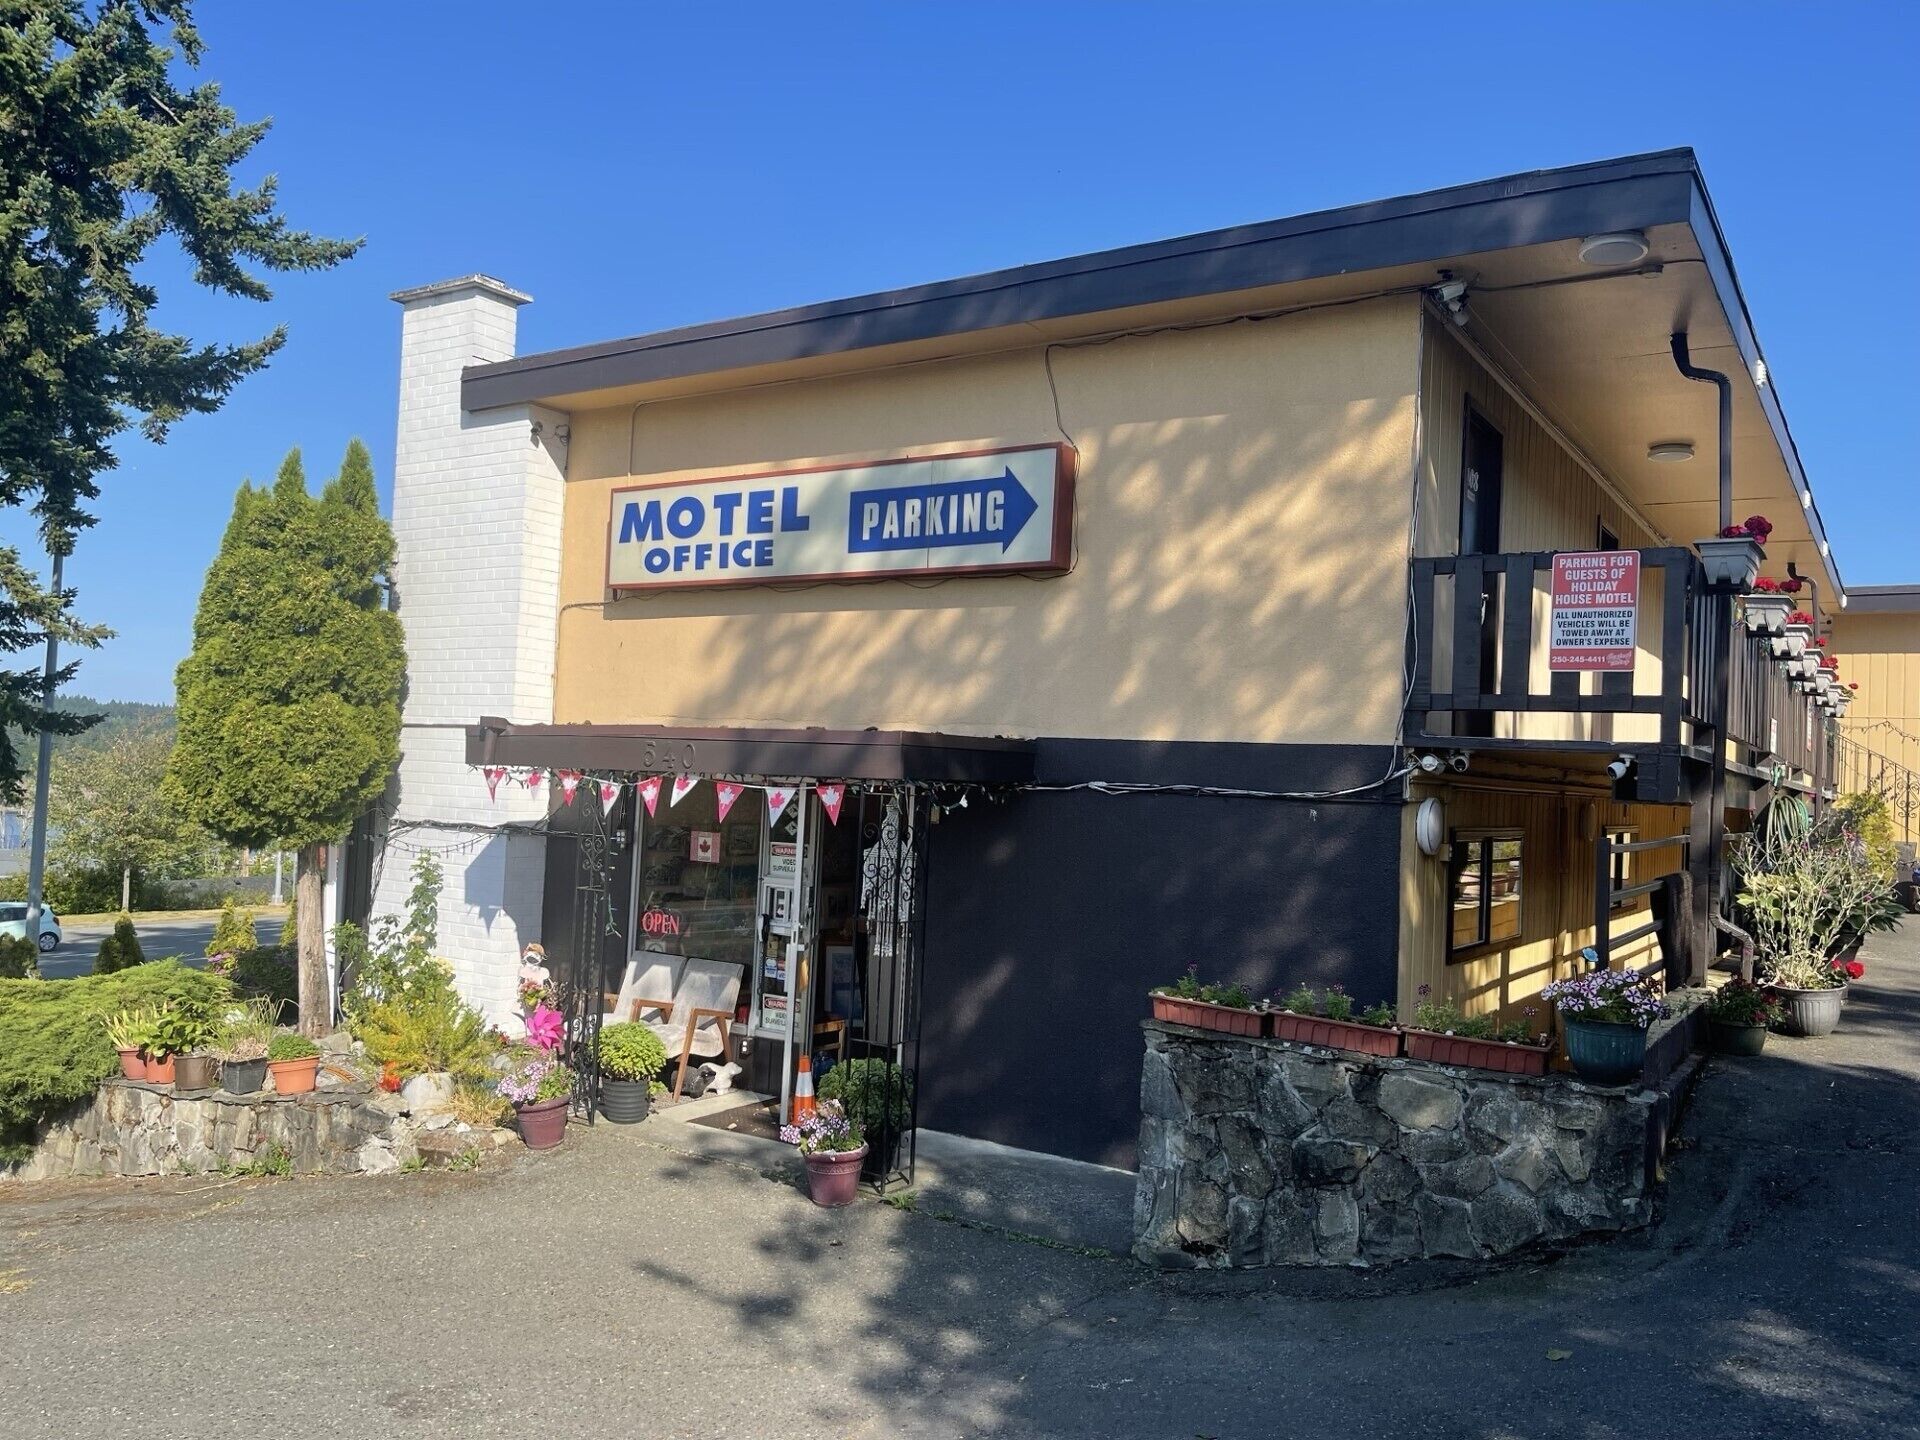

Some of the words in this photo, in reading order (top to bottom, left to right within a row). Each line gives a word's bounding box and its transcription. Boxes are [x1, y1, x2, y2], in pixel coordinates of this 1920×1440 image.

[619, 486, 810, 543] MOTEL
[862, 490, 1005, 540] PARKING
[644, 540, 774, 573] OFFICE
[1559, 556, 1607, 569] PARKING
[1610, 555, 1633, 567] FOR
[1565, 568, 1607, 580] GUESTS
[1611, 568, 1626, 579] OF
[1571, 580, 1618, 592] HOLIDAY
[1555, 594, 1592, 605] HOUSE
[1595, 592, 1634, 604] MOTEL
[1555, 611, 1569, 620] ALL
[1571, 610, 1633, 619] UNAUTHORIZED
[1557, 620, 1595, 628] VEHICLES
[1597, 620, 1617, 628] WILL
[1619, 619, 1630, 628] BE
[1562, 629, 1589, 637] TOWED
[1590, 629, 1613, 637] AWAY
[1615, 628, 1625, 636] AT
[1556, 638, 1592, 646] OWNER'S
[1594, 637, 1631, 646] EXPENSE
[1552, 655, 1606, 663] 250-245-4411
[642, 911, 680, 936] OPEN
